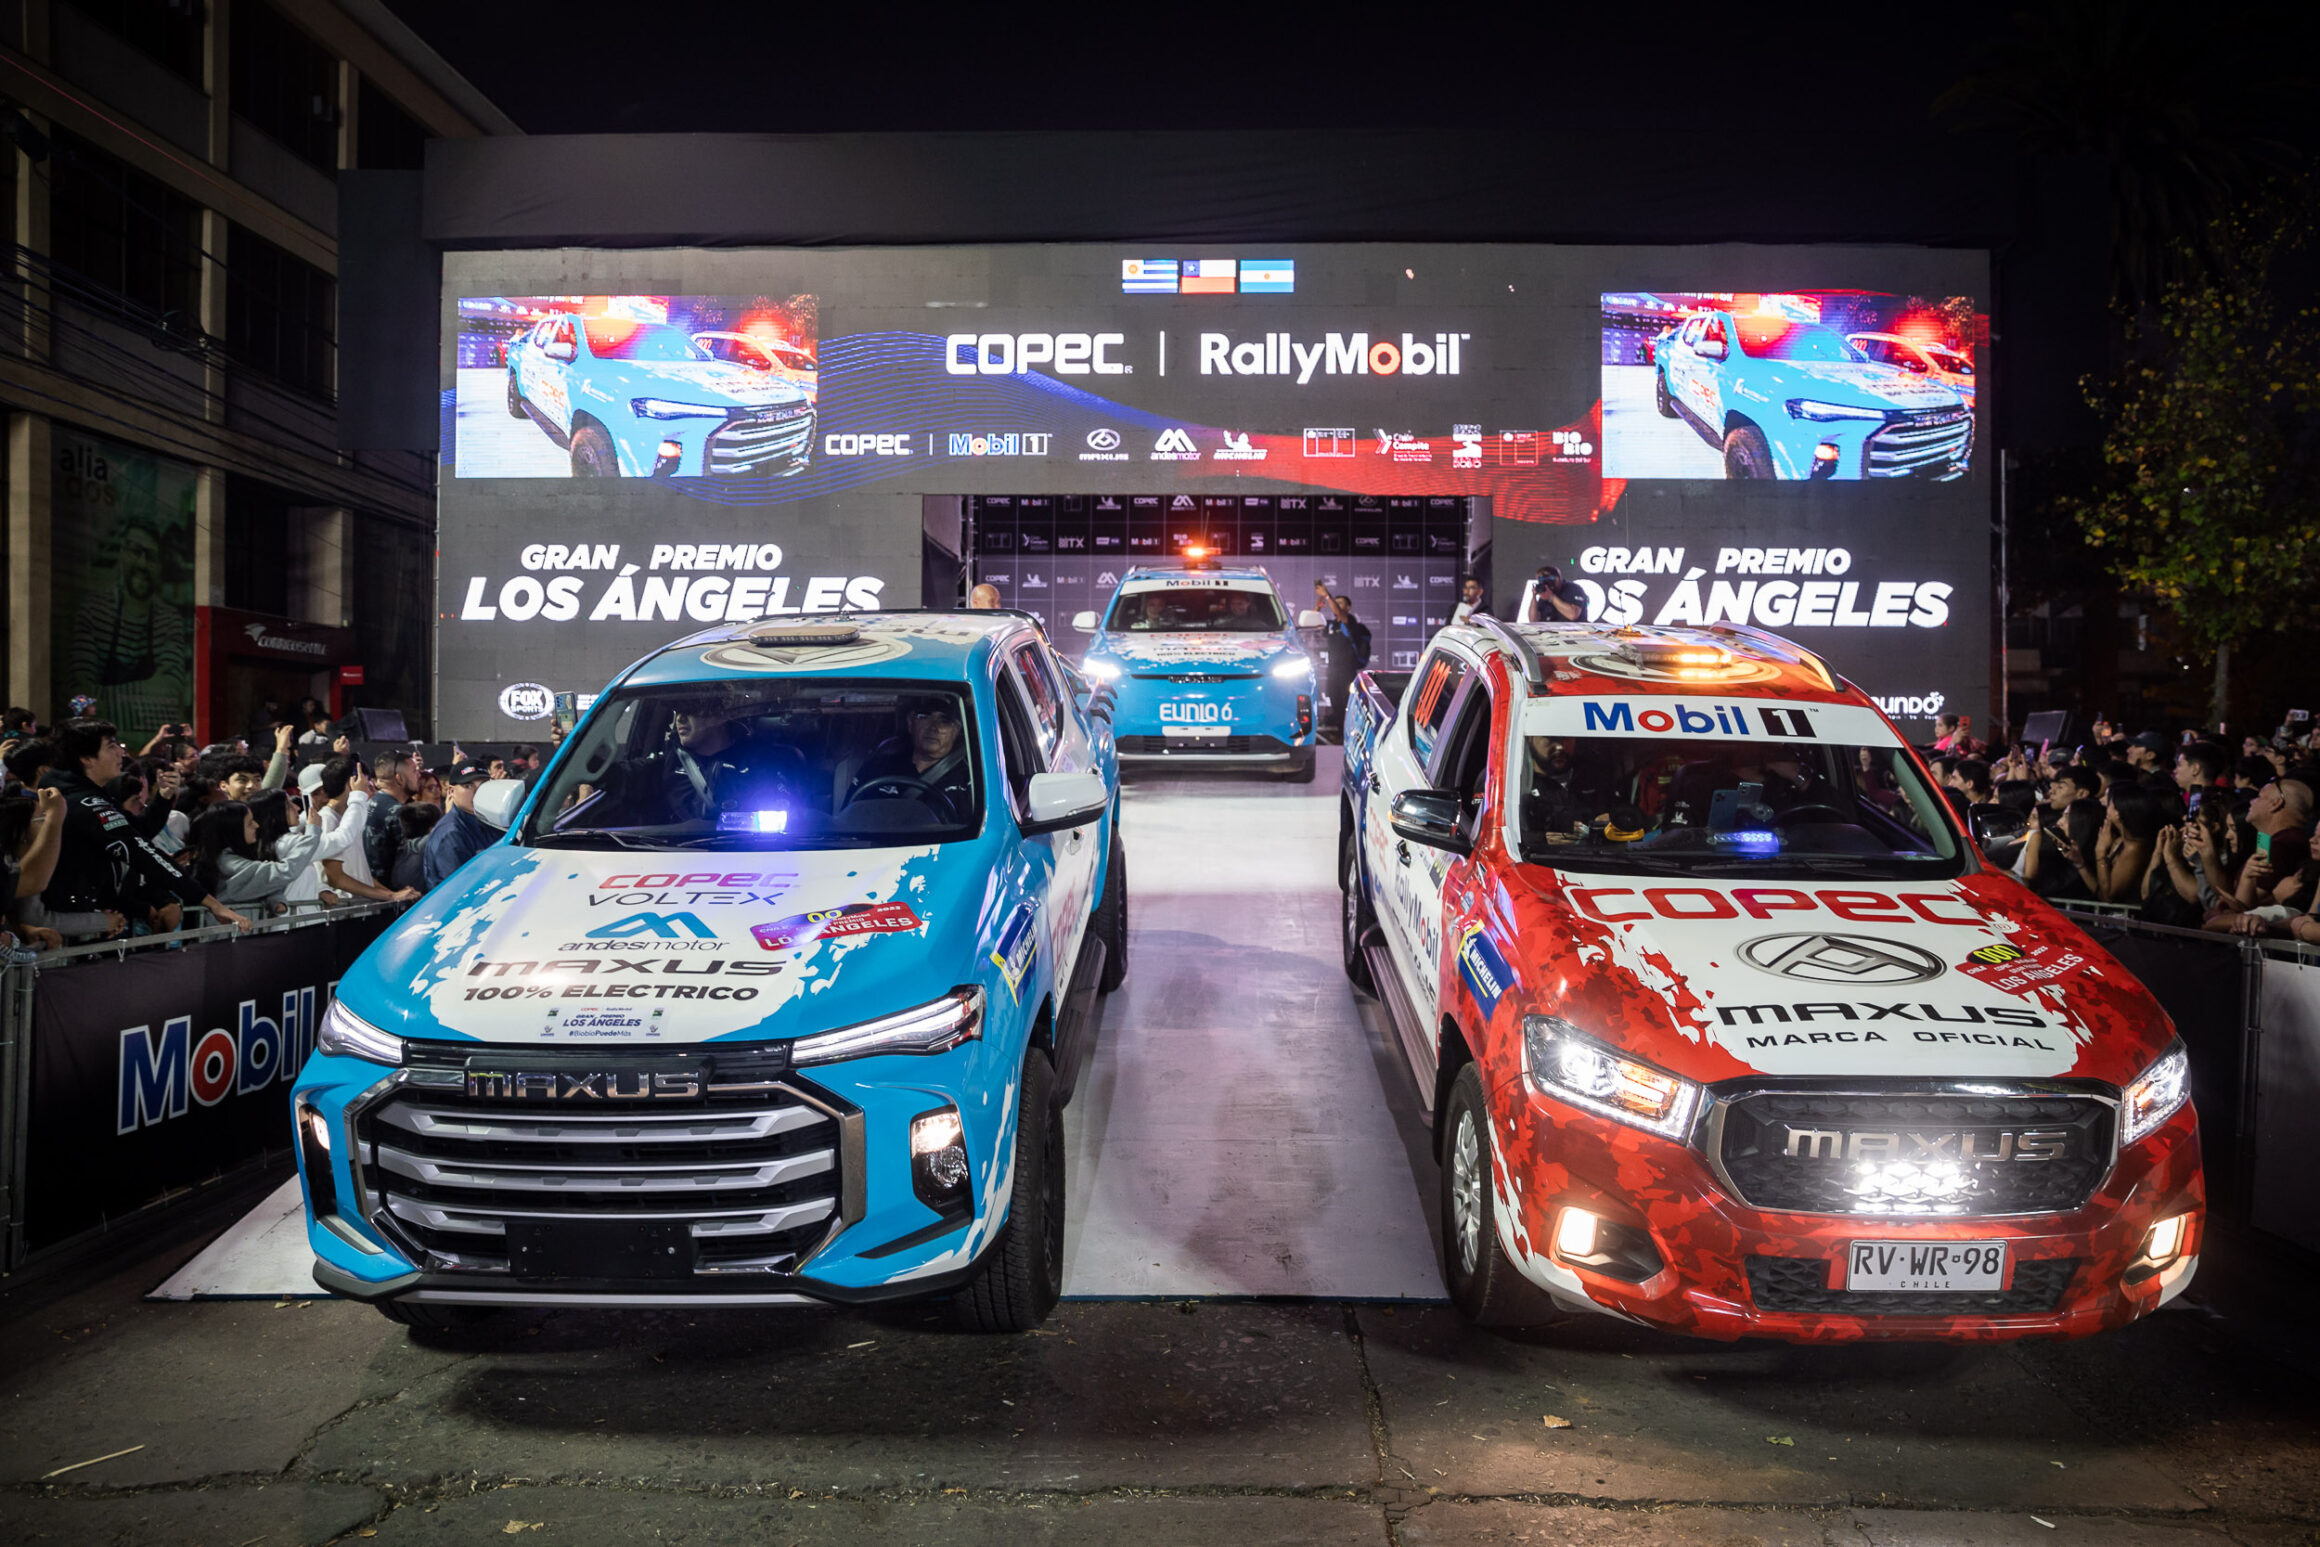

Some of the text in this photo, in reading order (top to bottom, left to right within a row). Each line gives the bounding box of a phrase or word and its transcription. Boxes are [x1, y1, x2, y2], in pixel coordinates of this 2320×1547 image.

[945, 333, 1124, 375] COPEC
[1200, 332, 1461, 385] RallyMobil
[825, 434, 911, 456] COPEC
[949, 433, 1019, 456] Mobil
[521, 543, 783, 571] GRAN PREMIO
[1579, 547, 1852, 576] GRAN PREMIO
[460, 564, 885, 622] LOS ÁNGELES
[1652, 567, 1954, 627] ÁNGELES
[510, 690, 543, 706] FOX
[1221, 703, 1232, 721] 6
[1583, 702, 1750, 735] Mobil
[589, 892, 785, 906] VOLTEX
[1567, 888, 1995, 927] COPEC
[807, 910, 842, 923] 00
[557, 939, 730, 951] andesmotor
[1973, 944, 2022, 963] 000
[1470, 949, 1502, 1000] MICHELIN
[1990, 975, 2028, 990] LOS
[464, 984, 759, 1001] 100% ELECTRICO
[562, 1019, 585, 1027] LOS
[1716, 1002, 2048, 1028] MAXUS
[1747, 1030, 2055, 1051] MARCA OFICIAL
[117, 985, 316, 1136] Mobil
[469, 1072, 699, 1099] MAXUS
[1900, 1280, 1952, 1289] CHILE
